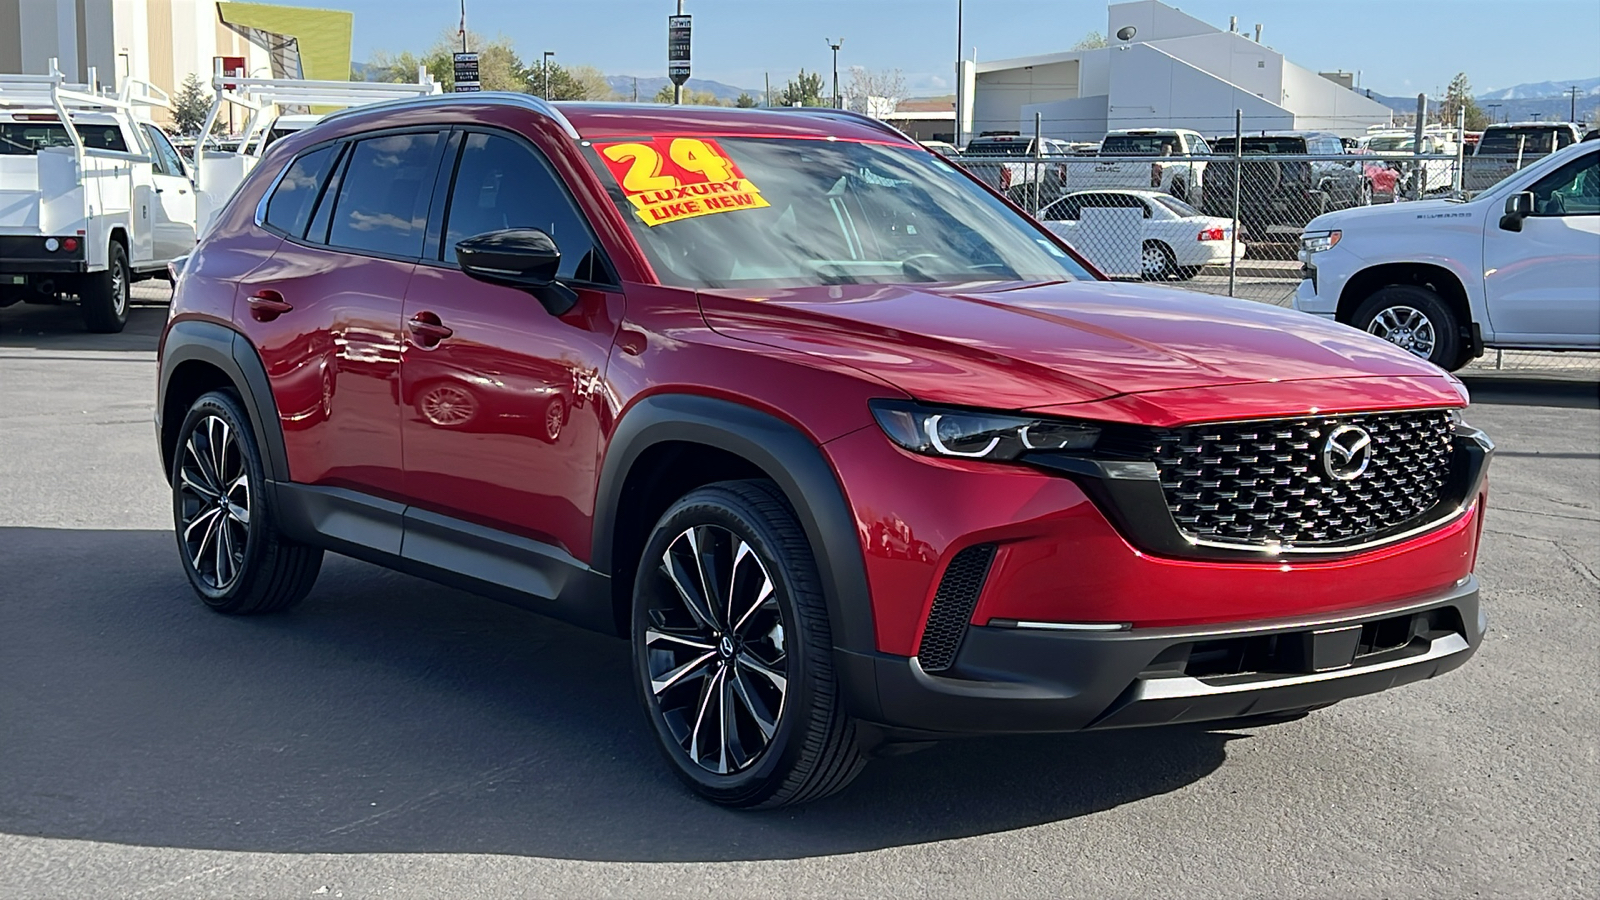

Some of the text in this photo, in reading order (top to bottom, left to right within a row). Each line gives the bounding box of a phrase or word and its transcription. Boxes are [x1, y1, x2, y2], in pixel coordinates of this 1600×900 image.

[603, 138, 736, 192] 24
[640, 180, 742, 206] LUXURY
[650, 194, 756, 221] LIKE NEW
